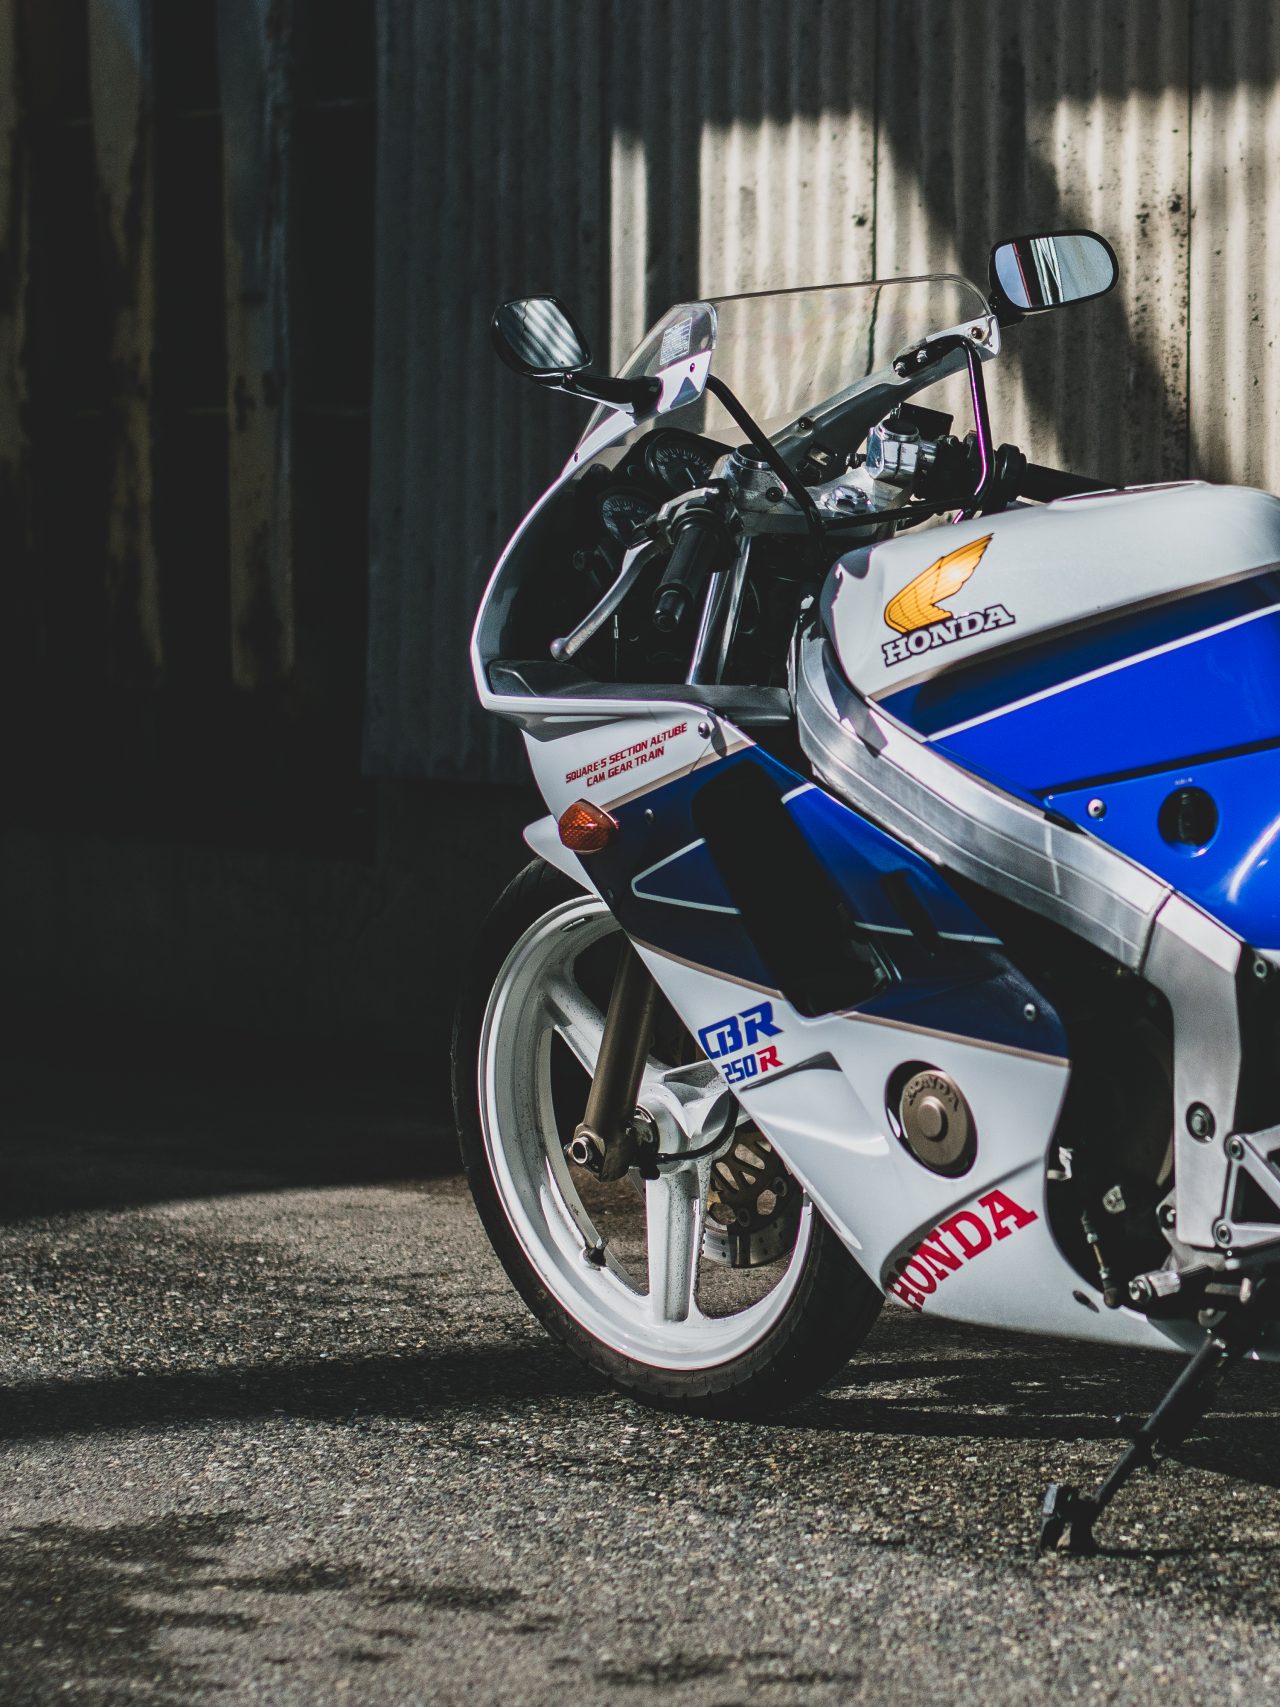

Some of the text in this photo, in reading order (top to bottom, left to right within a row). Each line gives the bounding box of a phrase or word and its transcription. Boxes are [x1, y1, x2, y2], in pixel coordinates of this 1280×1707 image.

[881, 603, 1016, 667] HONDA
[586, 746, 665, 787] CAM GEAR TRAIN
[609, 740, 648, 765] SECTION
[697, 1001, 785, 1060] CBR
[721, 1045, 785, 1085] 250R
[884, 1189, 1039, 1313] HONDA
